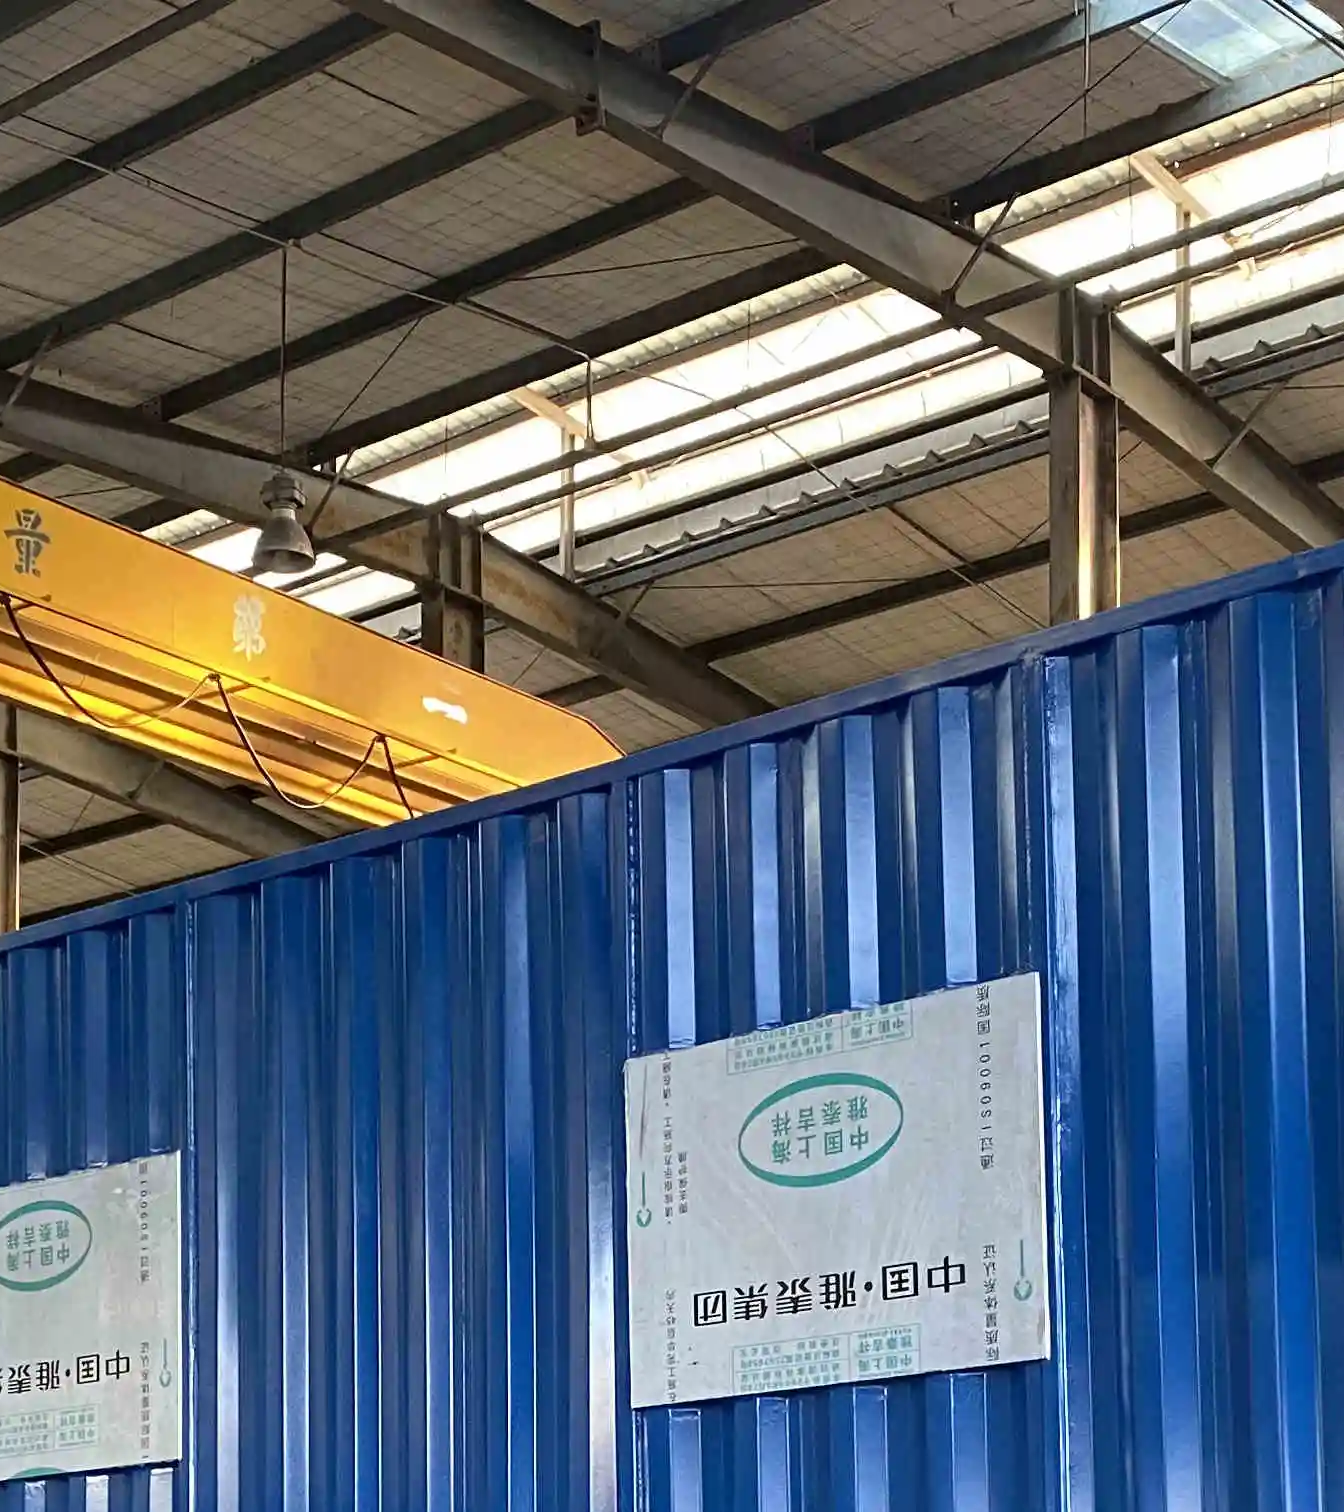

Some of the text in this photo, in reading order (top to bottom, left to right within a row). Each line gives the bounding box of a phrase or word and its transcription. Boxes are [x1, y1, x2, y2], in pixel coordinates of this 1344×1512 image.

[3, 506, 52, 578] 量
[771, 1095, 870, 1137] 雅泰吉祥
[771, 1125, 870, 1165] 中国上海
[692, 1255, 967, 1327] 中国·雅泰集团
